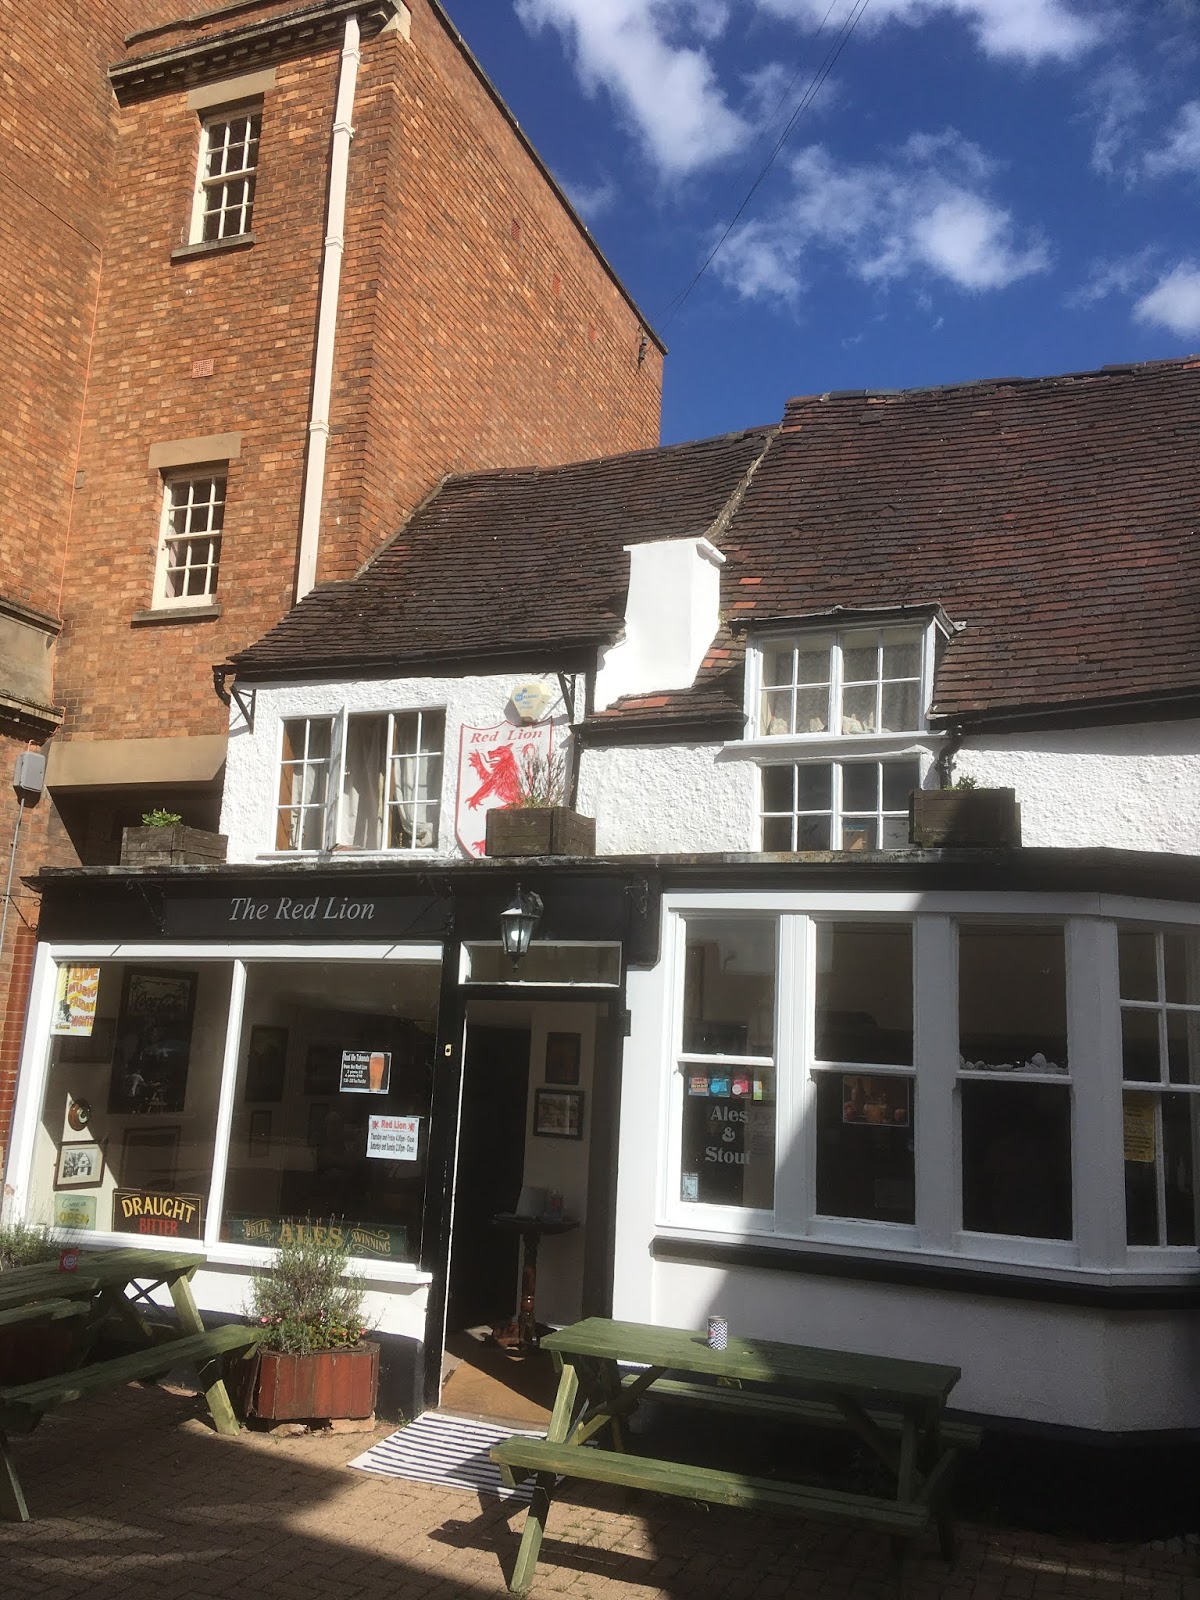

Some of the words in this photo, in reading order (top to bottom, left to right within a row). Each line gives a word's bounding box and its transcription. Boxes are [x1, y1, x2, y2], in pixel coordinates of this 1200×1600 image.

[470, 731, 499, 743] Red
[507, 730, 542, 742] Lion
[229, 897, 269, 920] The
[274, 896, 320, 920] Red
[323, 896, 375, 920] Lion
[72, 965, 98, 981] LIVE
[68, 981, 98, 998] MUSIC
[710, 1105, 750, 1123] Ales
[381, 1120, 393, 1129] Red
[394, 1121, 407, 1130] Lion
[722, 1126, 736, 1142] &
[705, 1146, 751, 1165] Stout
[122, 1196, 196, 1223] DRAUGHT
[57, 1212, 89, 1226] OPEN
[139, 1217, 179, 1235] BITTER
[245, 1221, 270, 1237] PRIZE
[278, 1223, 344, 1249] ALES
[352, 1231, 391, 1252] WINNING
